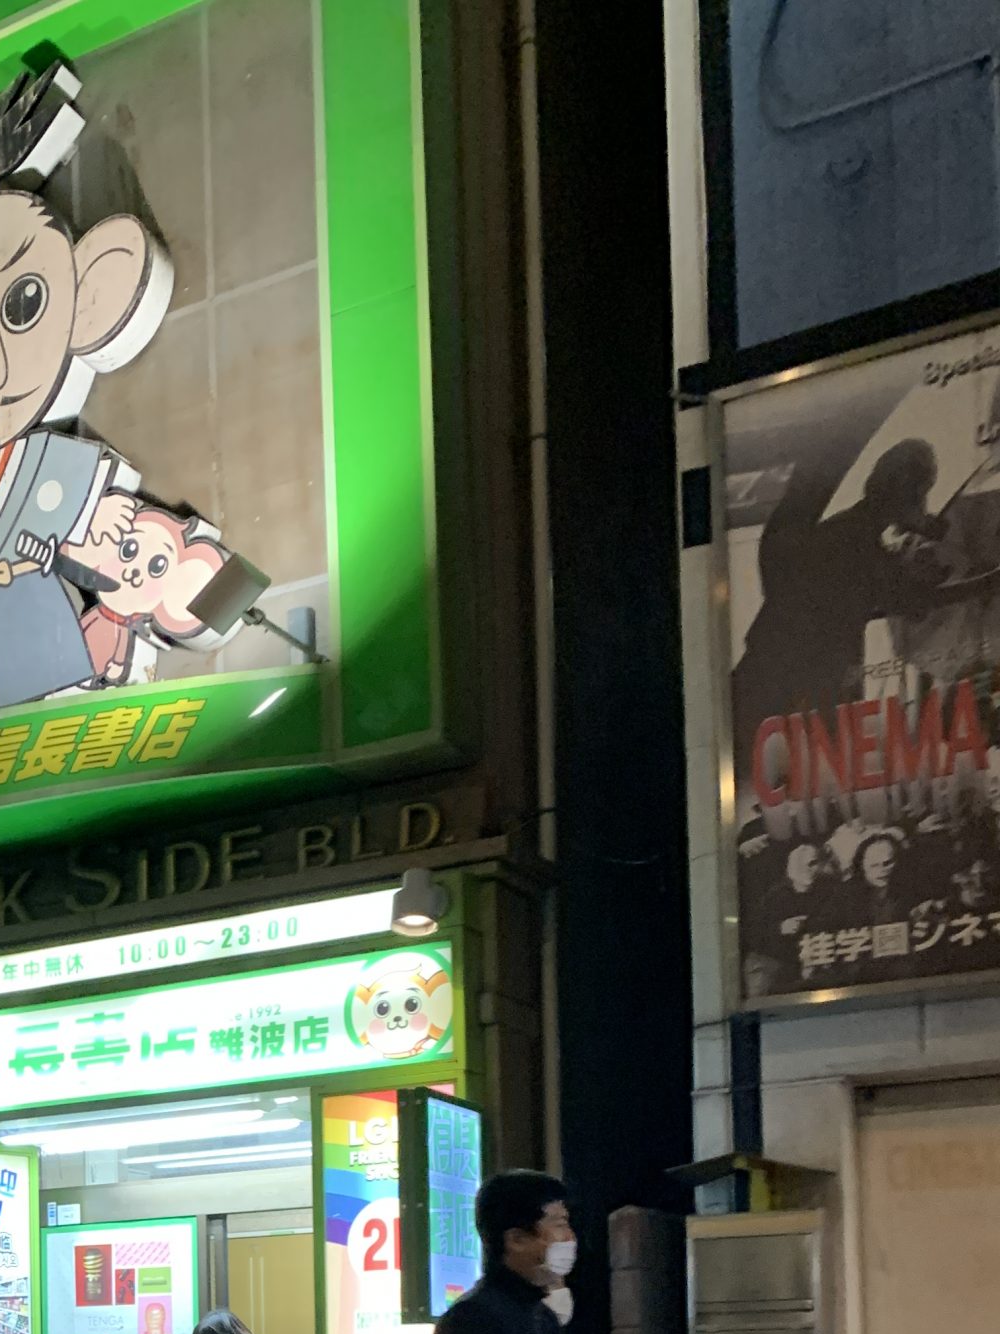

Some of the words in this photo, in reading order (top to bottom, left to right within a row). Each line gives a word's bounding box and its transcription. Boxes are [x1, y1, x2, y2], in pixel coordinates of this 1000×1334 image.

[752, 678, 988, 807] CINEMA
[66, 823, 263, 912] SIDE
[1, 953, 85, 982] 年中無休
[208, 1017, 329, 1062] 難波店
[349, 1116, 399, 1147] LG
[363, 1217, 400, 1271] 2
